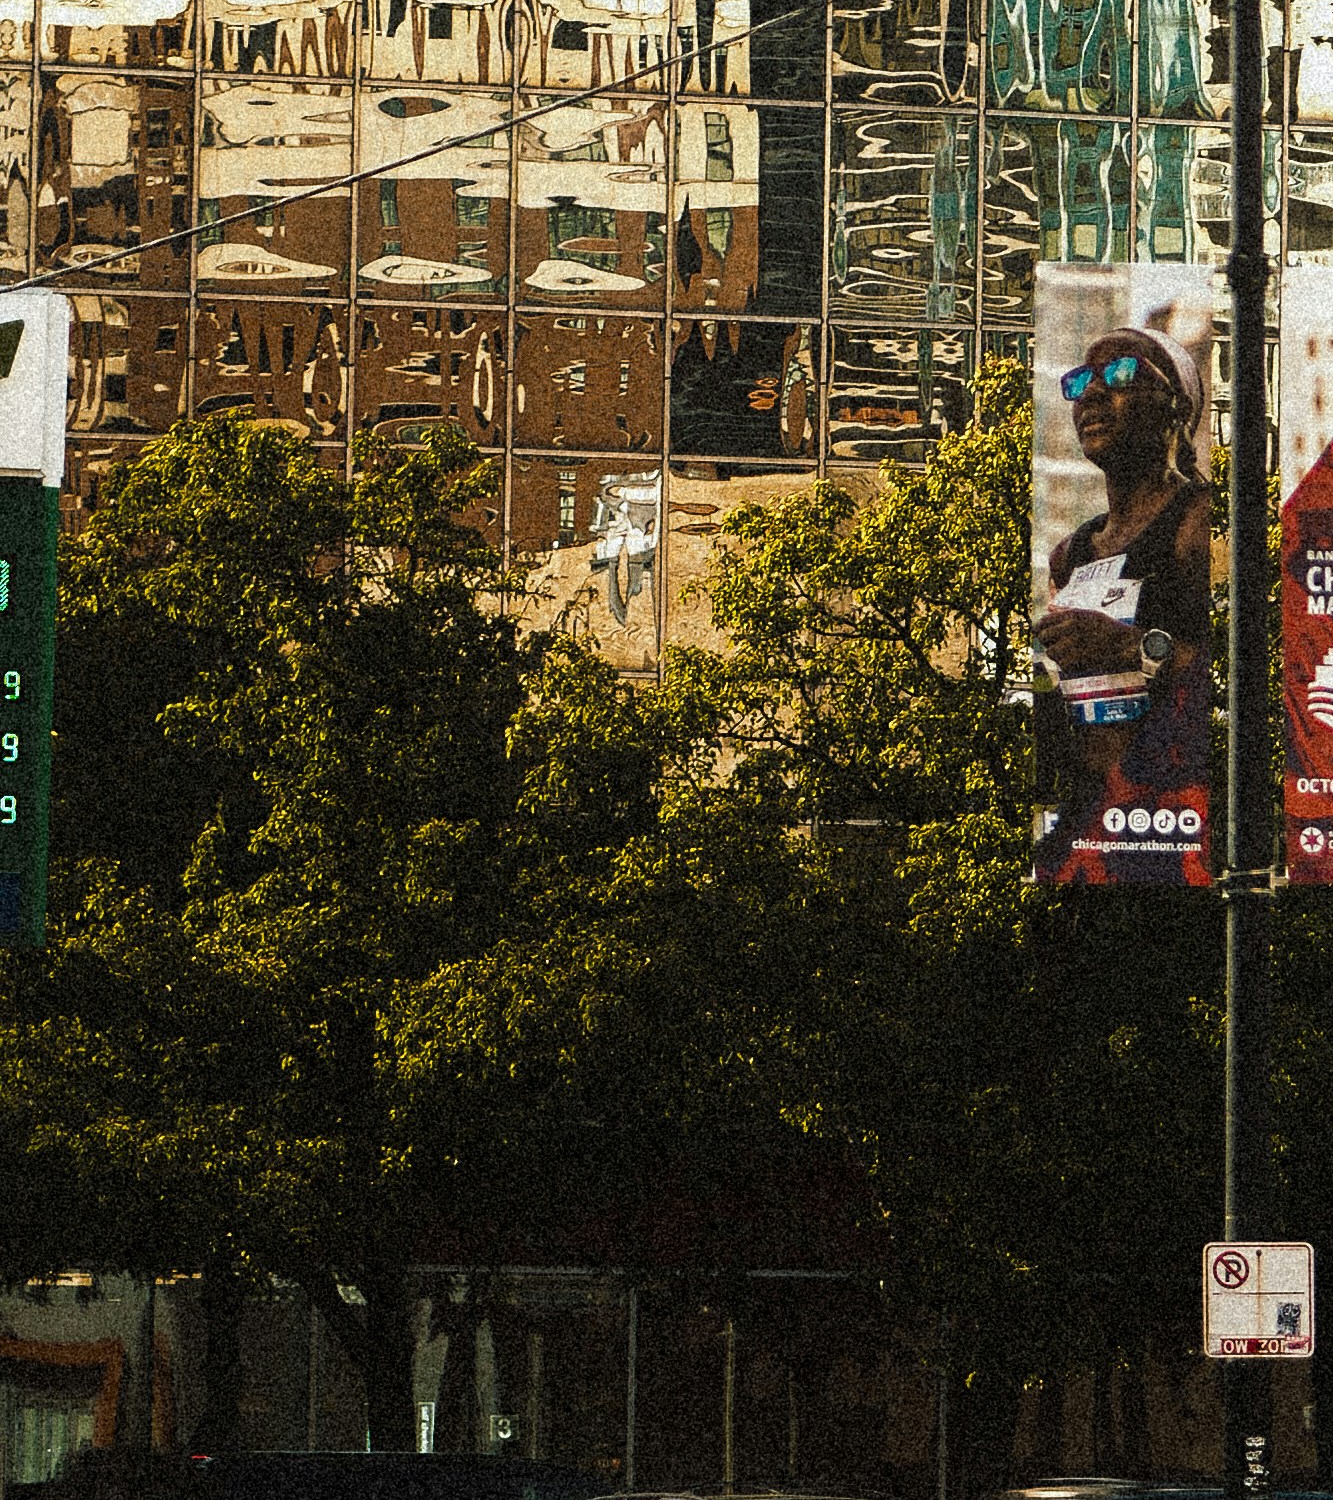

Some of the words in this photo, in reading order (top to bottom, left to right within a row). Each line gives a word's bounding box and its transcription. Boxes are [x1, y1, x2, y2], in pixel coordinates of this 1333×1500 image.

[1071, 838, 1202, 853] chicagomarathon.com
[1222, 1339, 1249, 1354] OW
[497, 1417, 513, 1440] 3
